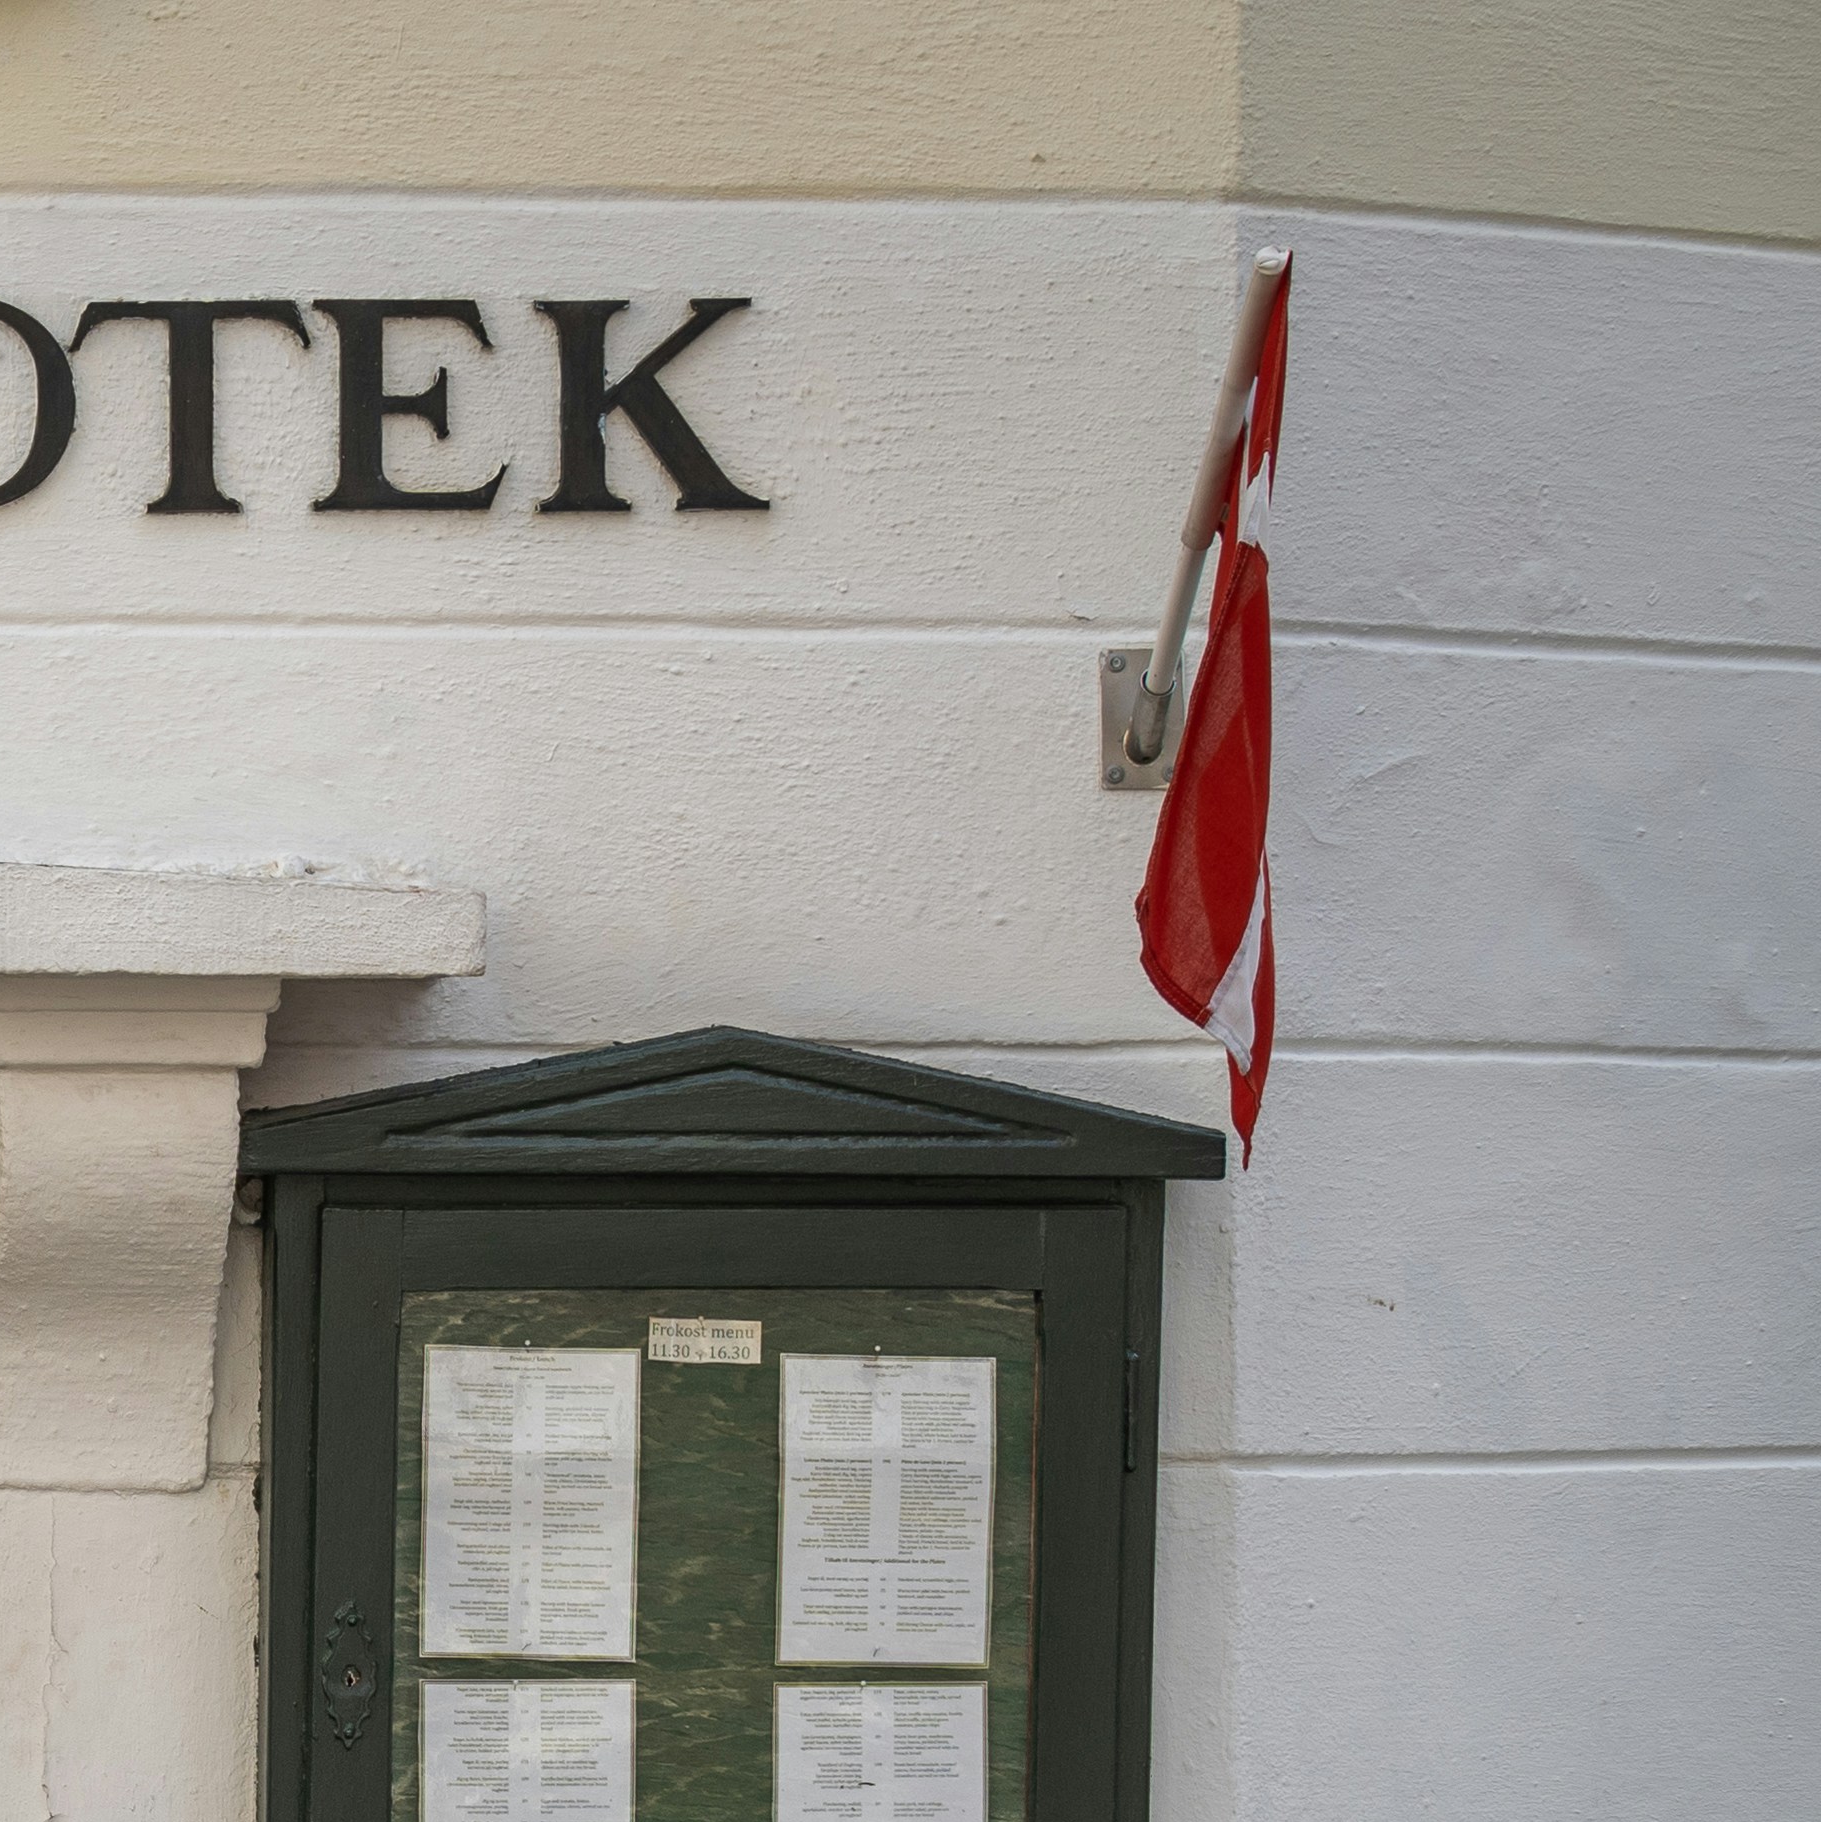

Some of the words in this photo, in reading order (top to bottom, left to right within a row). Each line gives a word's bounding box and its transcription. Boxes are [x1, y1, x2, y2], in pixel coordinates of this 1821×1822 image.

[652, 1322, 707, 1338] Frokost
[711, 1327, 754, 1339] menu
[652, 1344, 690, 1358] 11.30
[709, 1346, 750, 1360] 16.30
